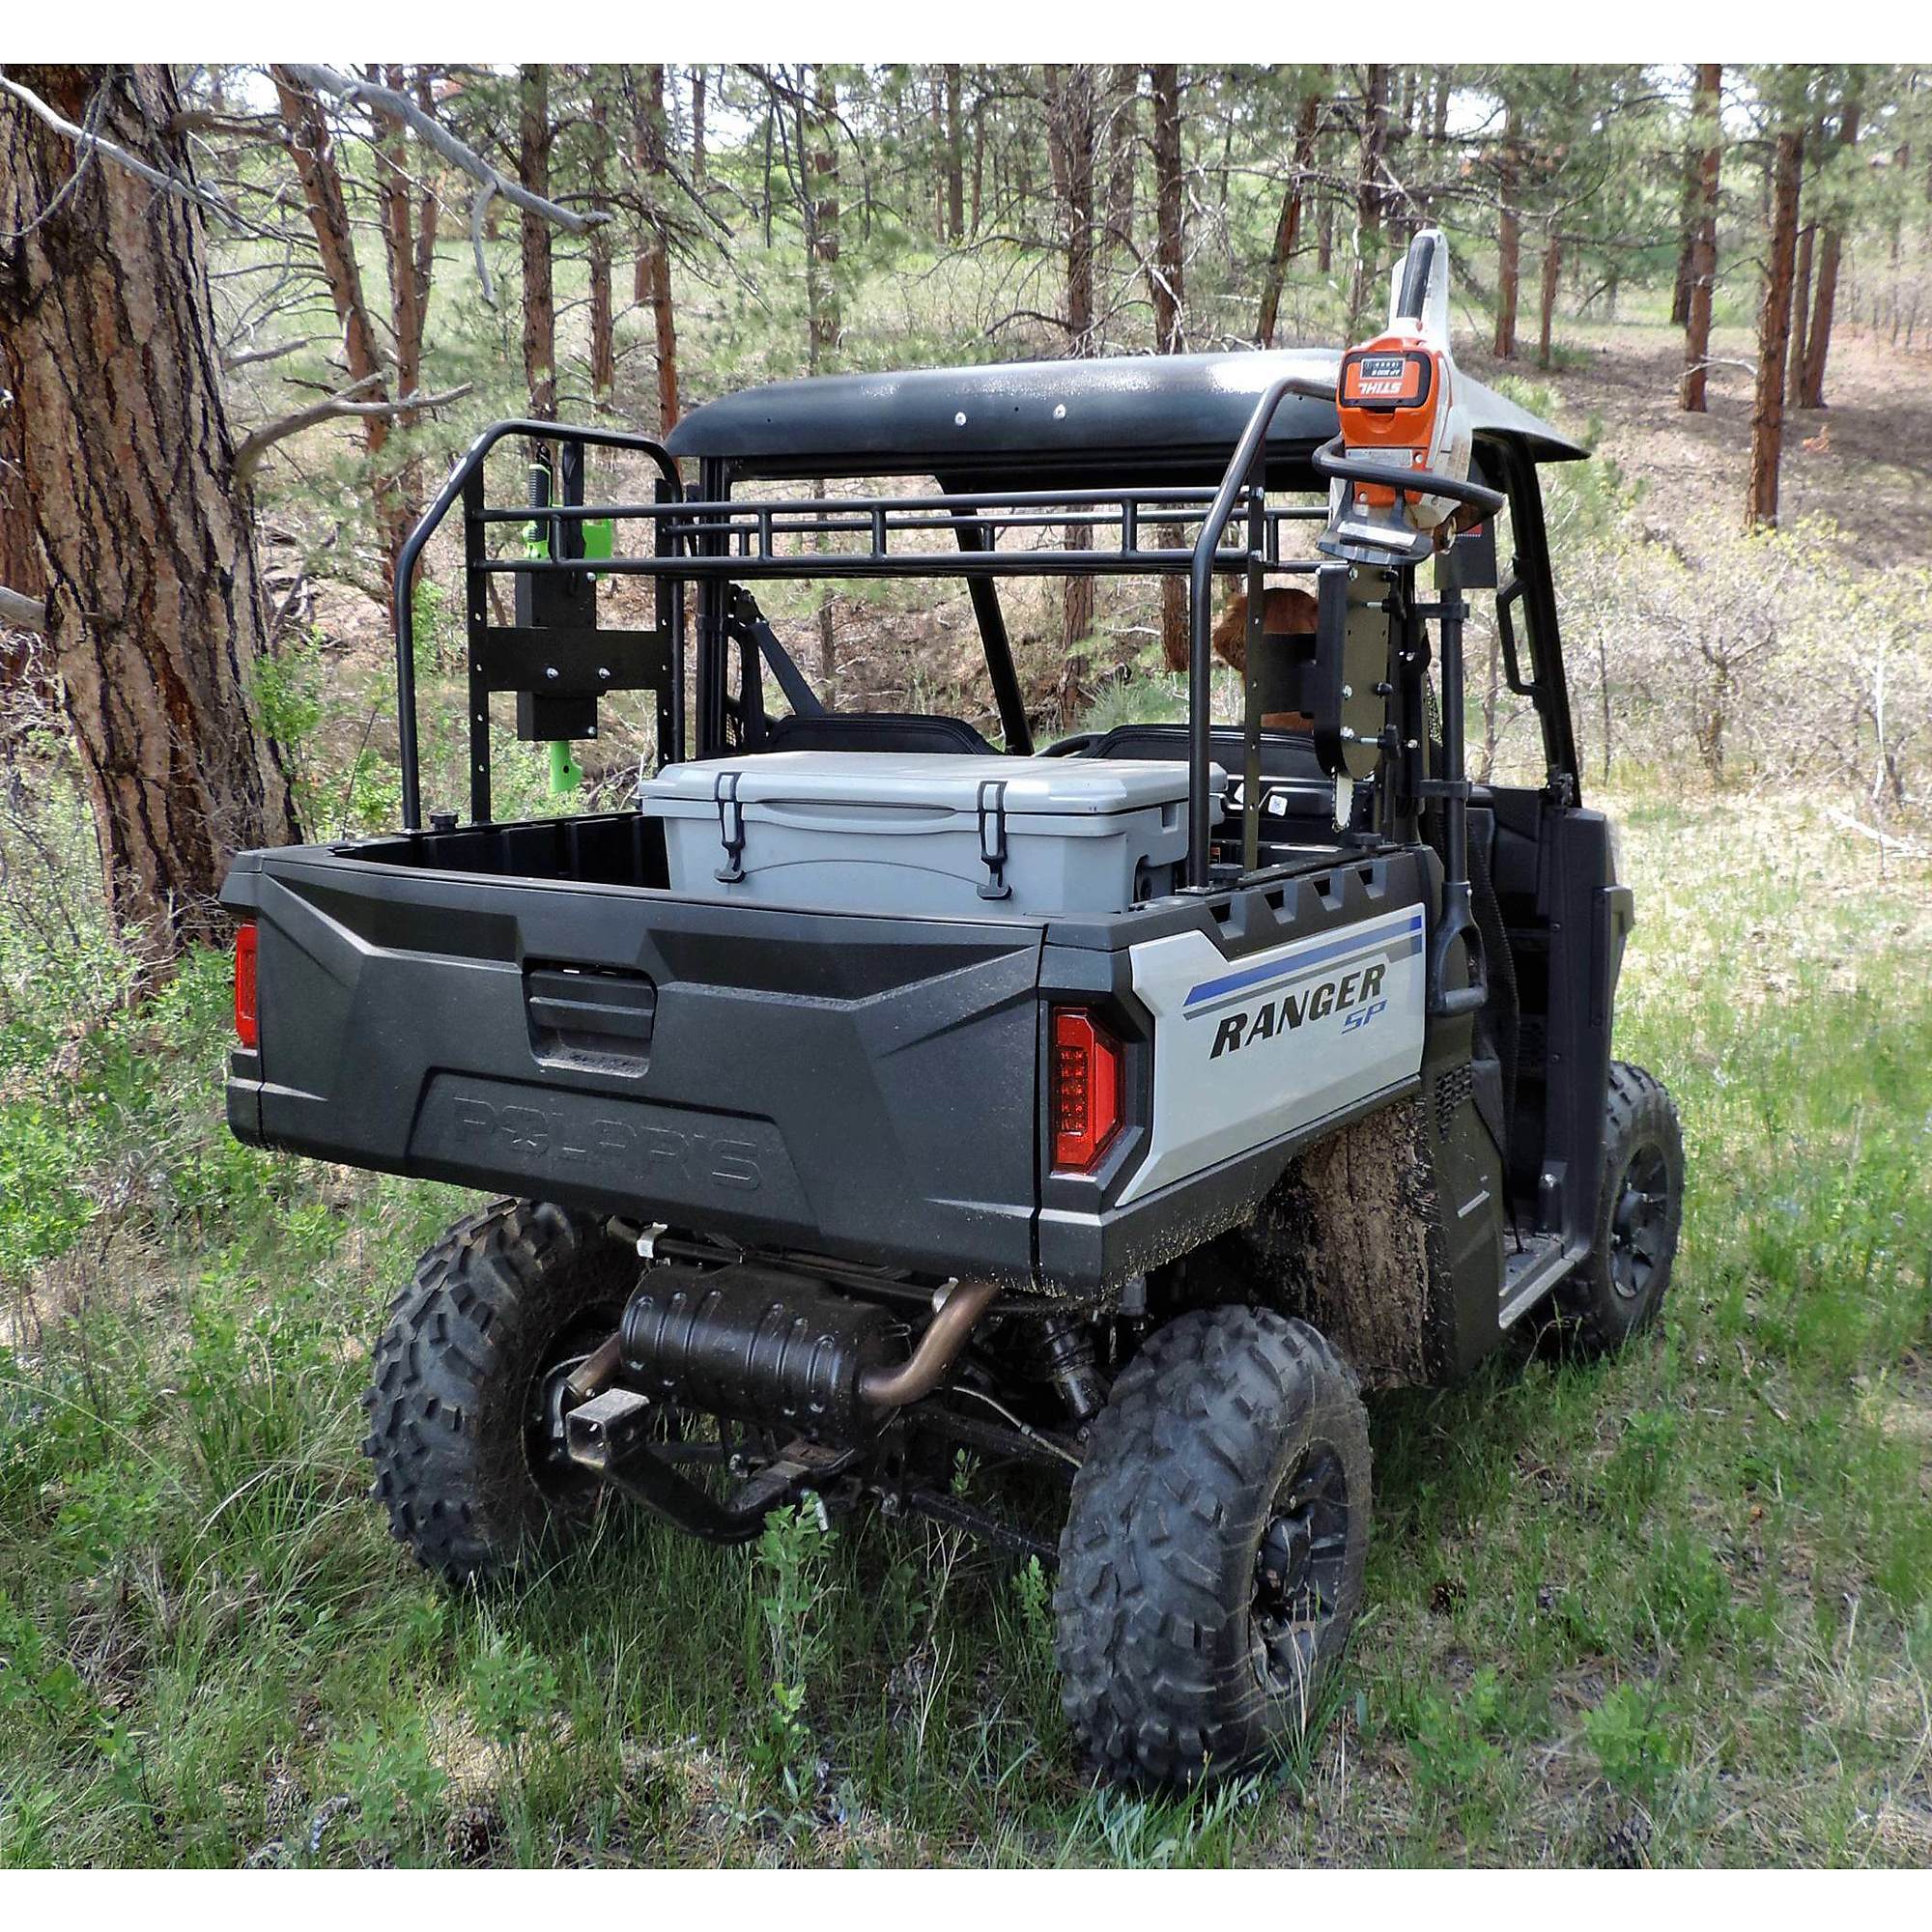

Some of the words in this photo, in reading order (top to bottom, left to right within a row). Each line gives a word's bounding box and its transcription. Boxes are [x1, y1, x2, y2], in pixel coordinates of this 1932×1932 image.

[1358, 382, 1403, 394] STIHL
[1209, 964, 1386, 1060] RANGER
[1341, 999, 1388, 1035] SP
